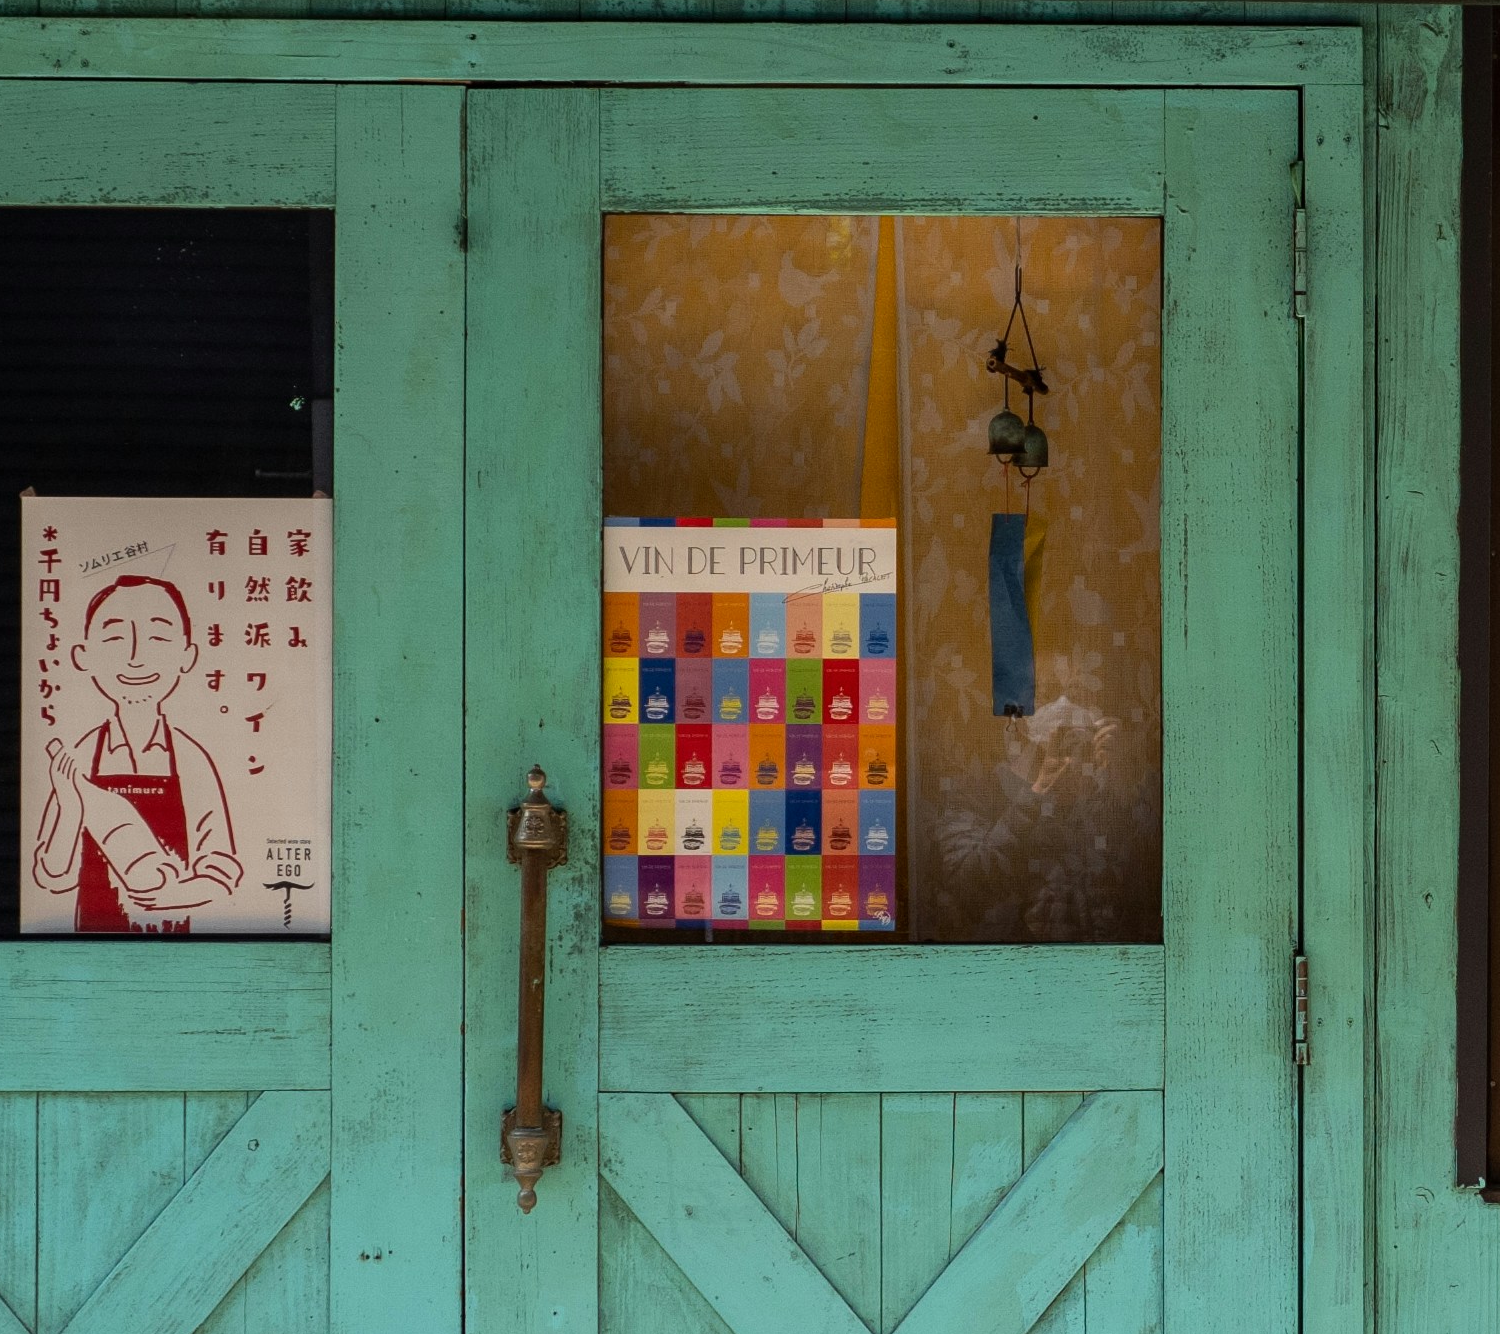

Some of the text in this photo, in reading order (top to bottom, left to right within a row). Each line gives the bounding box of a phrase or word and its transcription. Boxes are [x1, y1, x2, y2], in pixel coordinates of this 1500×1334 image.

[78, 540, 150, 573] ソムリエ谷村
[618, 546, 878, 576] VIN DE PRIMEUR
[285, 528, 313, 648] 家飲み
[244, 528, 277, 776] 自然派ワイン
[107, 784, 164, 795] tanimura
[266, 847, 312, 861] ALTER
[277, 863, 302, 877] EGO
